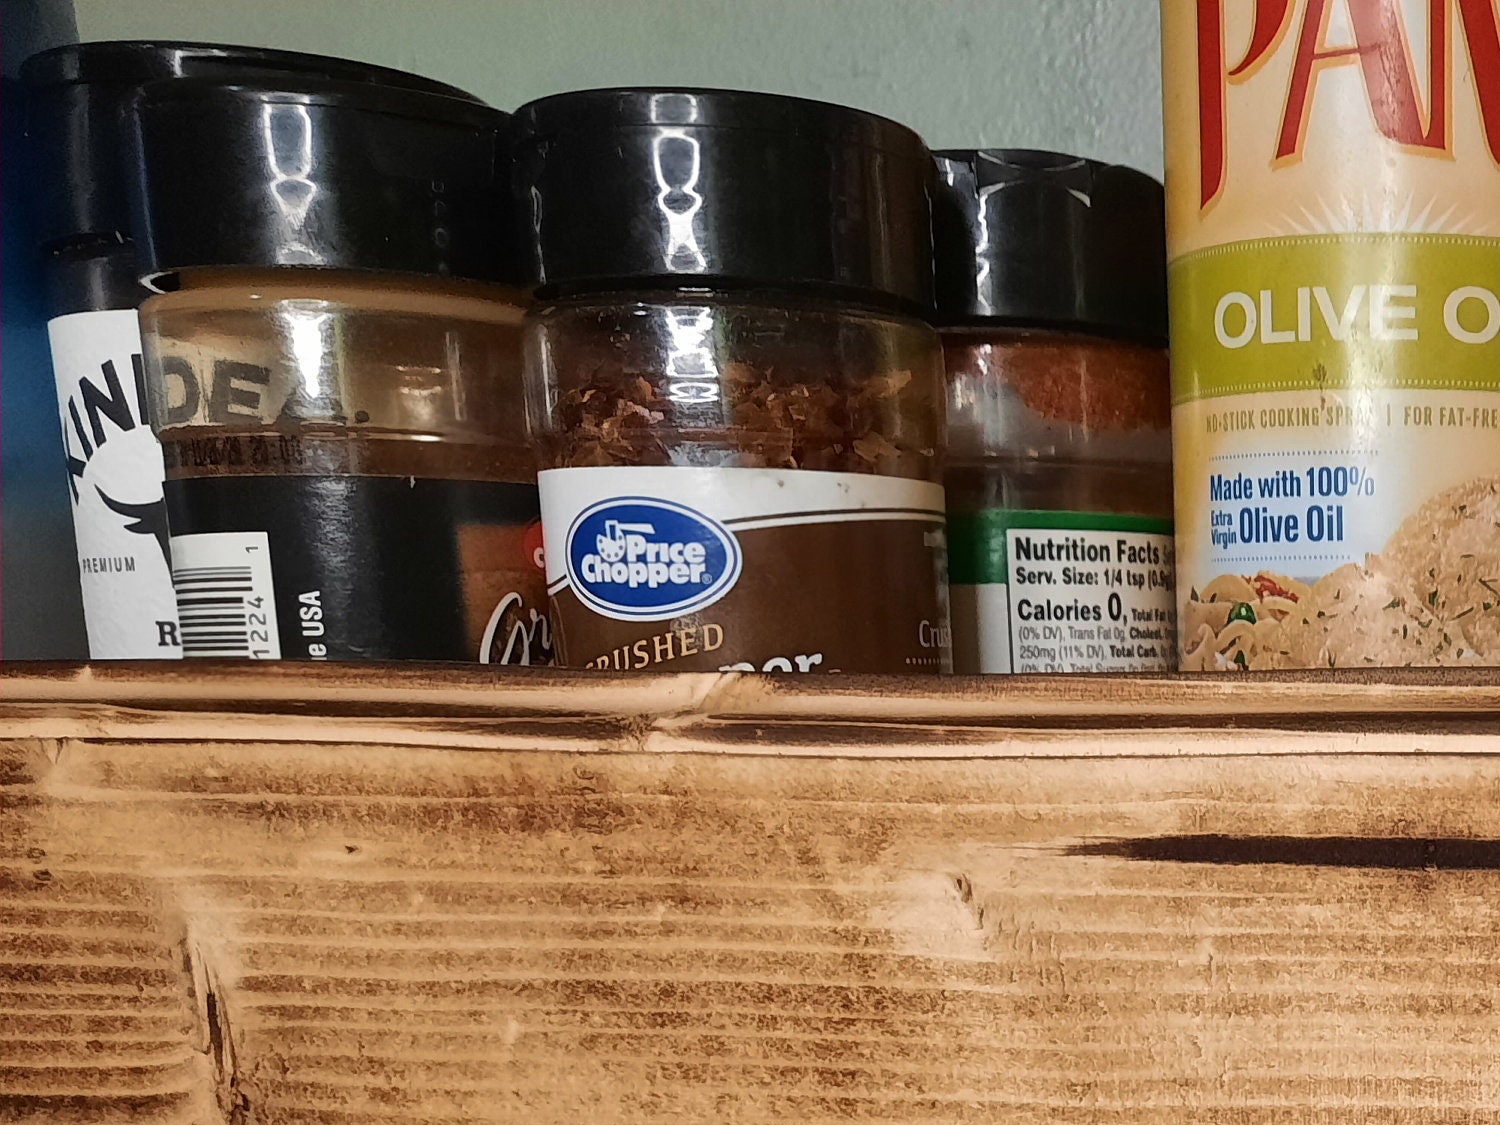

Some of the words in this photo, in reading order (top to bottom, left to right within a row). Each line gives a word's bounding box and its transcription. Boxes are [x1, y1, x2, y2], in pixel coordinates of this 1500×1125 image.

[1213, 284, 1420, 350] OLIVE
[1260, 407, 1320, 429] COOKING
[1403, 405, 1433, 426] FOR
[1209, 472, 1254, 501] Made
[1258, 470, 1301, 499] with
[1306, 466, 1376, 498] 100%
[1210, 509, 1233, 527] Extra
[1239, 506, 1299, 544] Olive
[1306, 505, 1344, 542] Oil
[624, 534, 707, 563] Price
[1015, 537, 1110, 562] Nutrition
[1117, 540, 1160, 564] Facts
[1210, 528, 1237, 550] Virgin
[82, 556, 136, 574] PREMIUM
[581, 553, 707, 588] Chopper
[1016, 566, 1057, 585] Serv.
[1062, 566, 1098, 585] Size:
[1104, 568, 1122, 587] 1/4
[1127, 570, 1145, 590] tsp
[299, 590, 325, 637] USA
[1017, 598, 1102, 621] Calories
